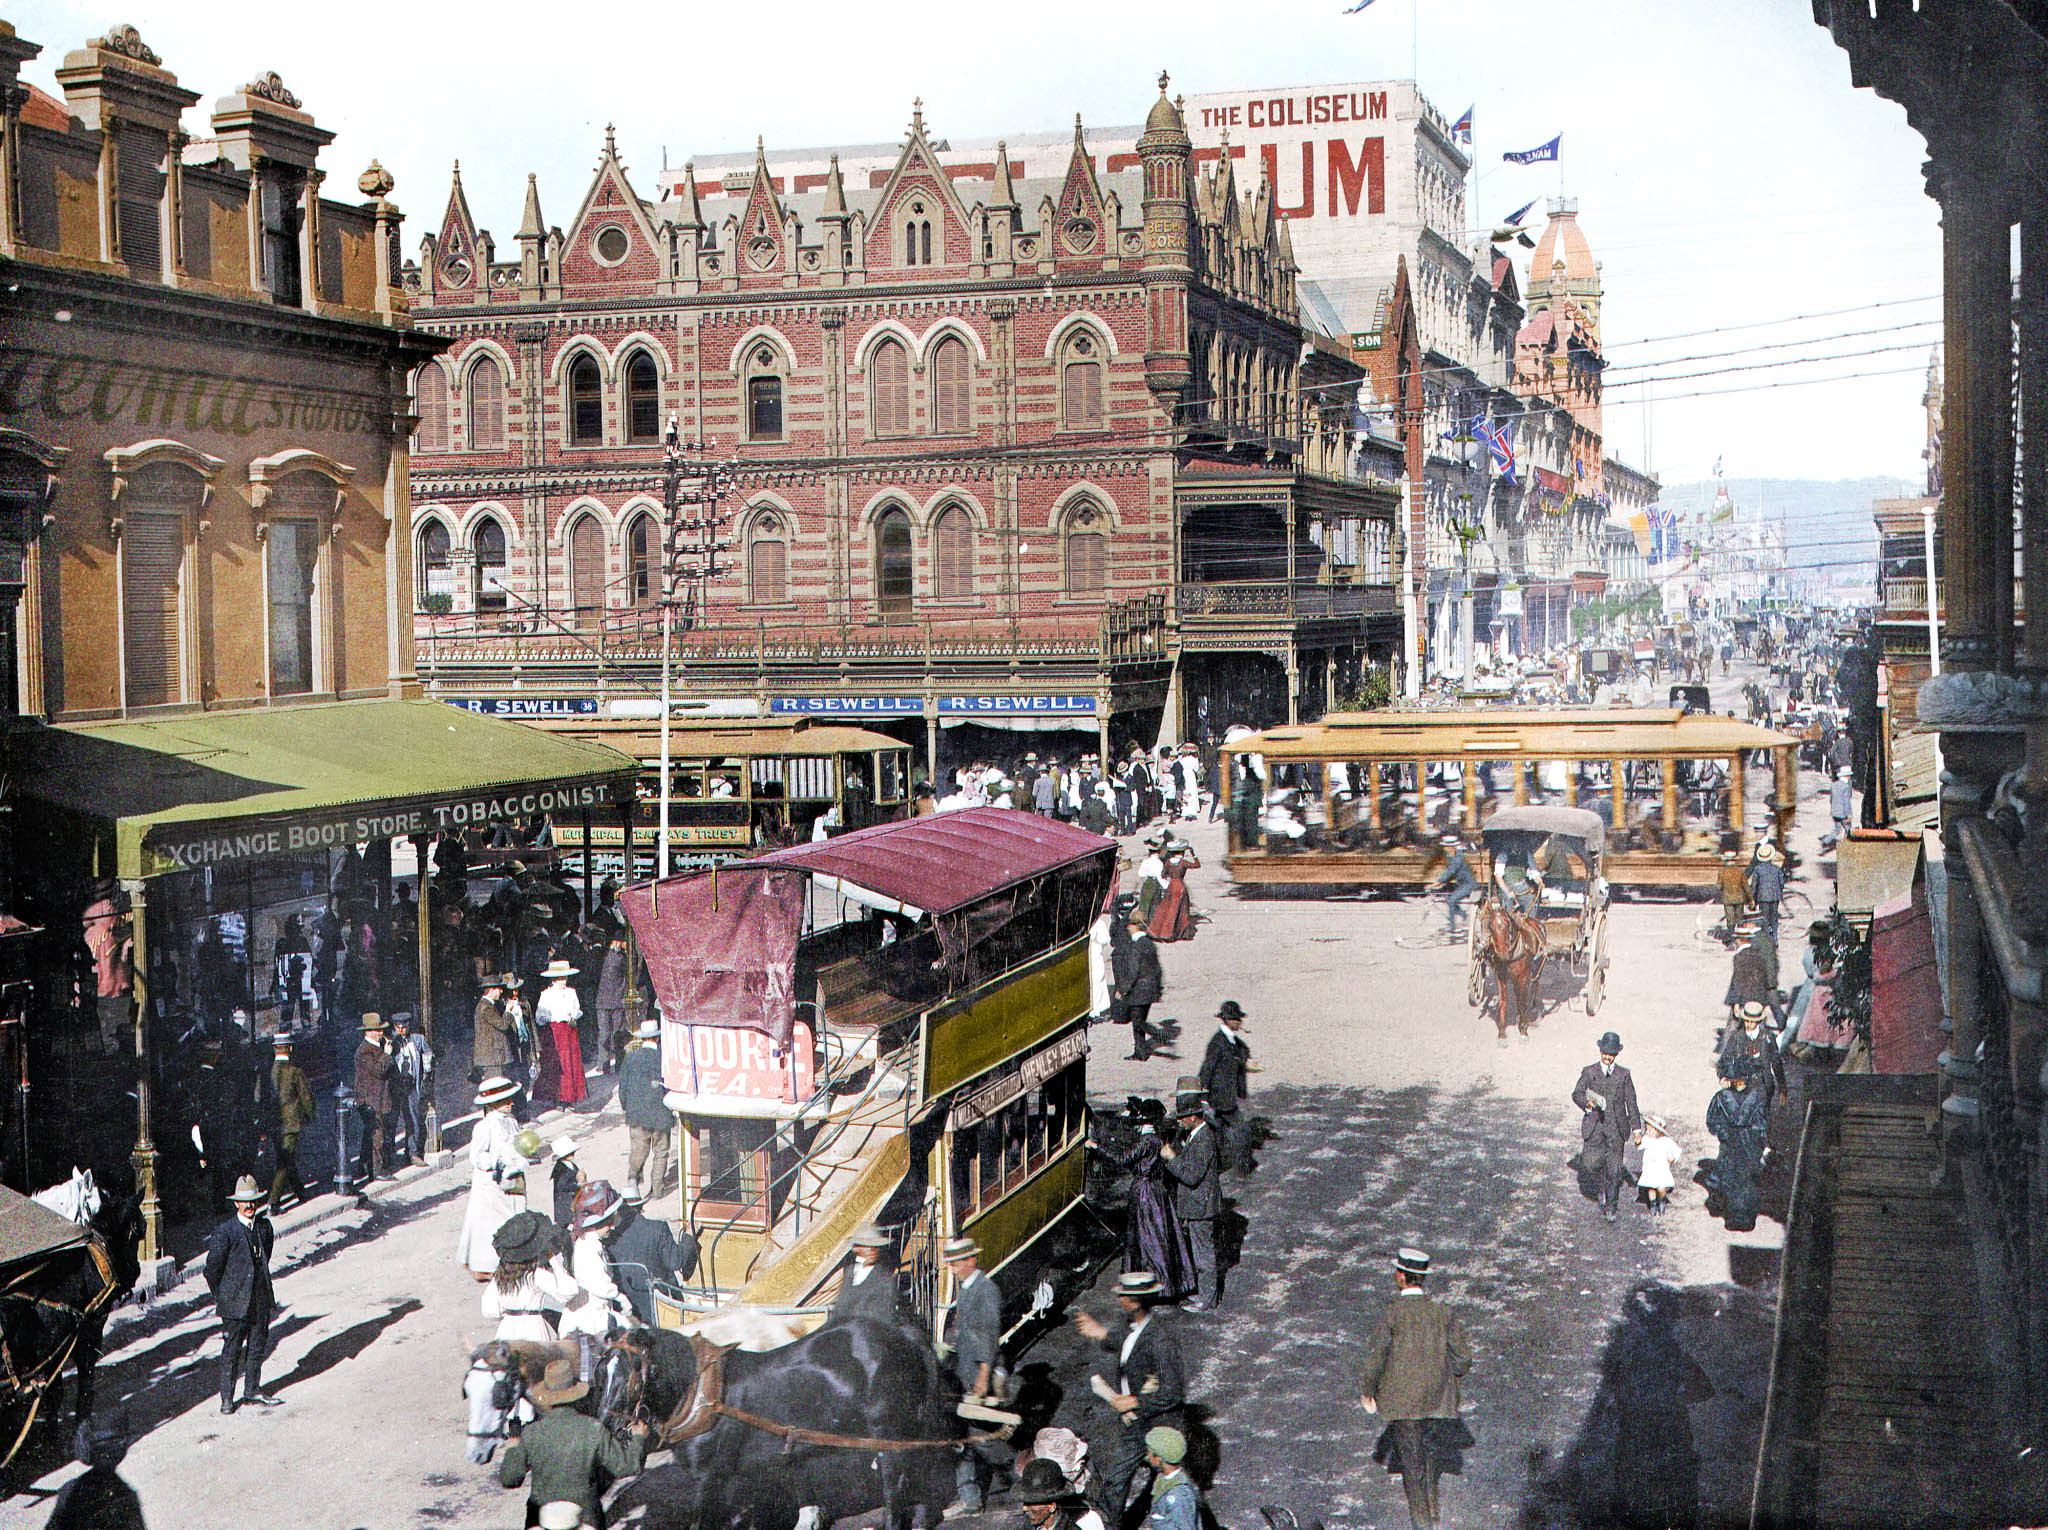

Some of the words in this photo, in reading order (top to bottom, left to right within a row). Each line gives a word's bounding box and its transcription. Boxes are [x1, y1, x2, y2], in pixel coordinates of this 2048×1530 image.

[1201, 106, 1242, 127] THE
[1248, 91, 1387, 128] COLISEUM
[495, 700, 574, 713] SEWELL
[288, 822, 350, 849] BOOT
[694, 828, 738, 840] TRUST
[1022, 1048, 1059, 1087] HENLEY
[1060, 1033, 1088, 1067] BEACH
